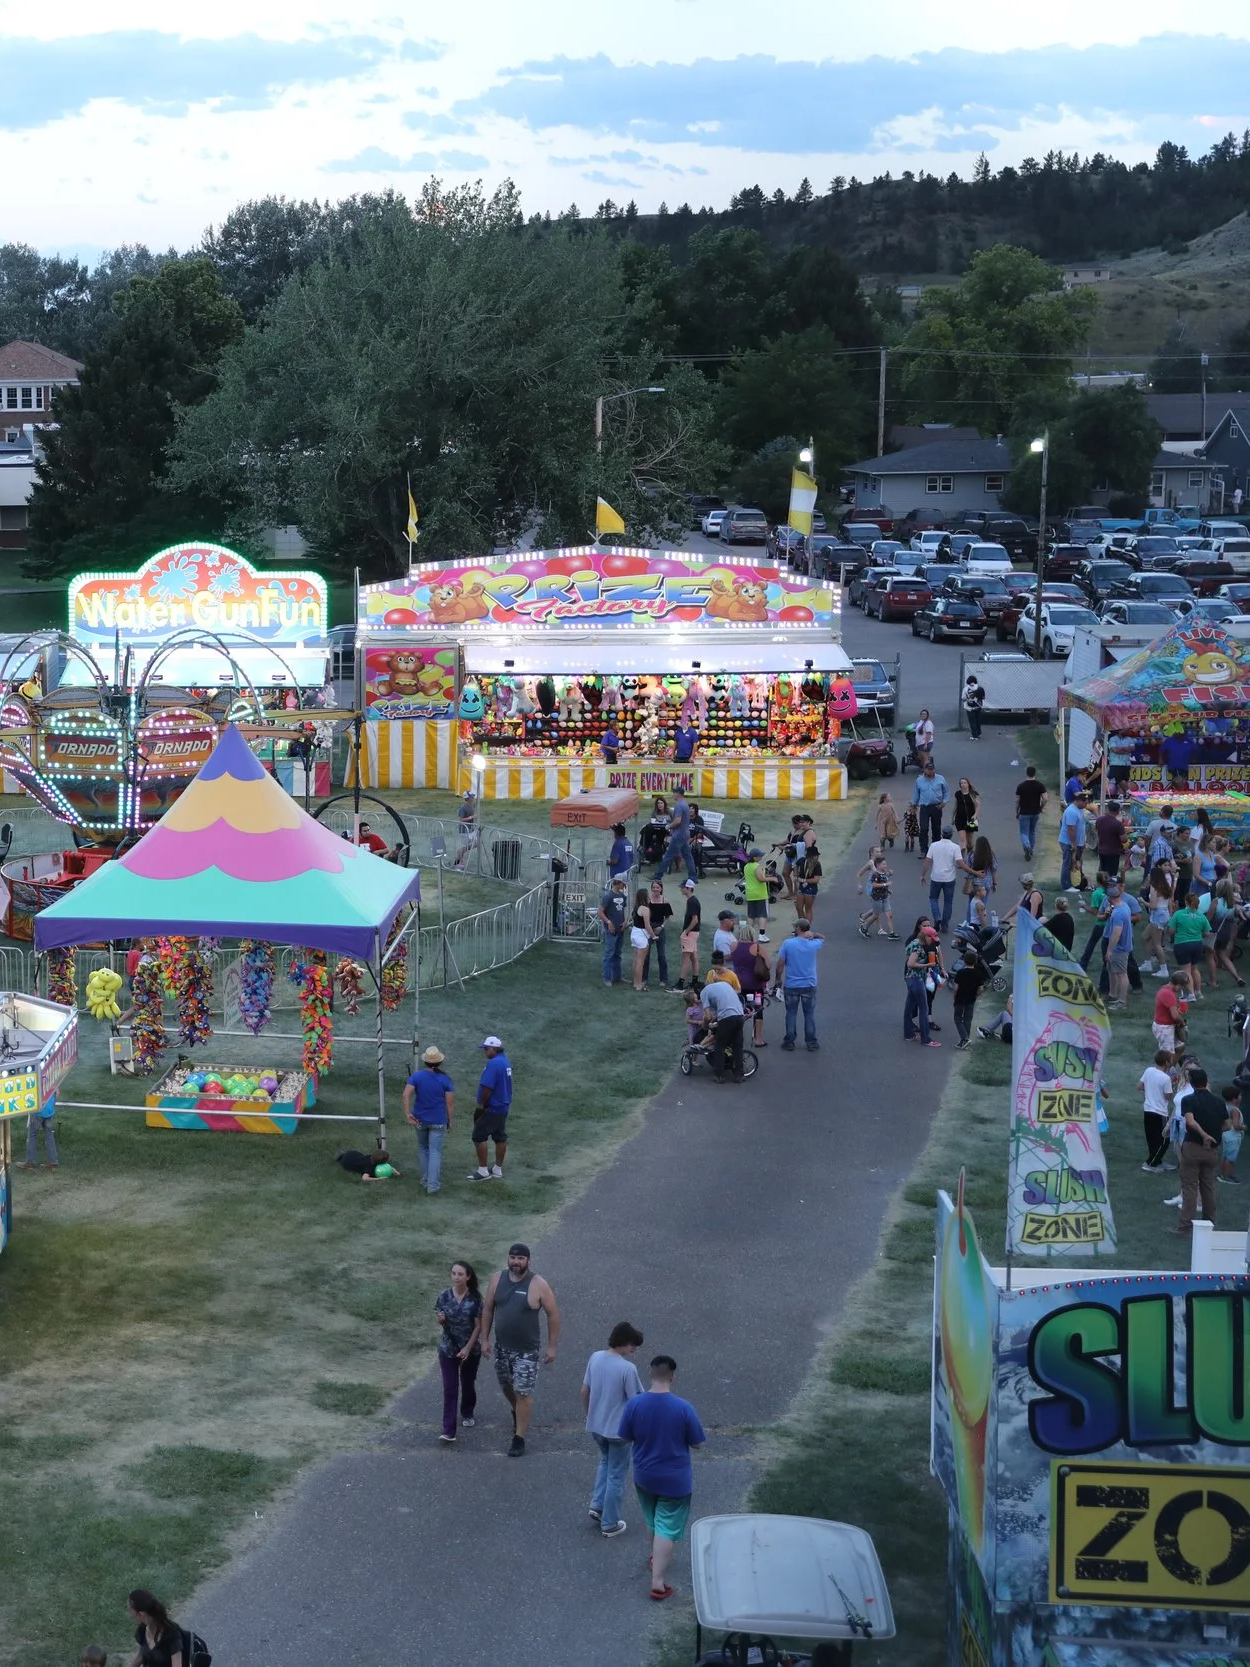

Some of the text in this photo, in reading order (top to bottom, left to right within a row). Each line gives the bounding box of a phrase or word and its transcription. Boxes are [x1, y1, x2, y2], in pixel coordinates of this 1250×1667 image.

[77, 592, 187, 627] Water
[515, 597, 677, 621] Factory
[1178, 627, 1228, 642] LIVE
[1127, 713, 1161, 721] GET
[1163, 711, 1219, 719] YOUR
[609, 772, 693, 792] PRIZE EVERYTIME
[567, 812, 586, 823] EXIT
[566, 894, 584, 902] EXIT
[1037, 968, 1105, 1011] ZON
[1023, 1166, 1108, 1206] SLUSH
[1027, 1214, 1101, 1241] ZONE
[1027, 1290, 1250, 1456] SLU
[1075, 1484, 1250, 1587] ZO
